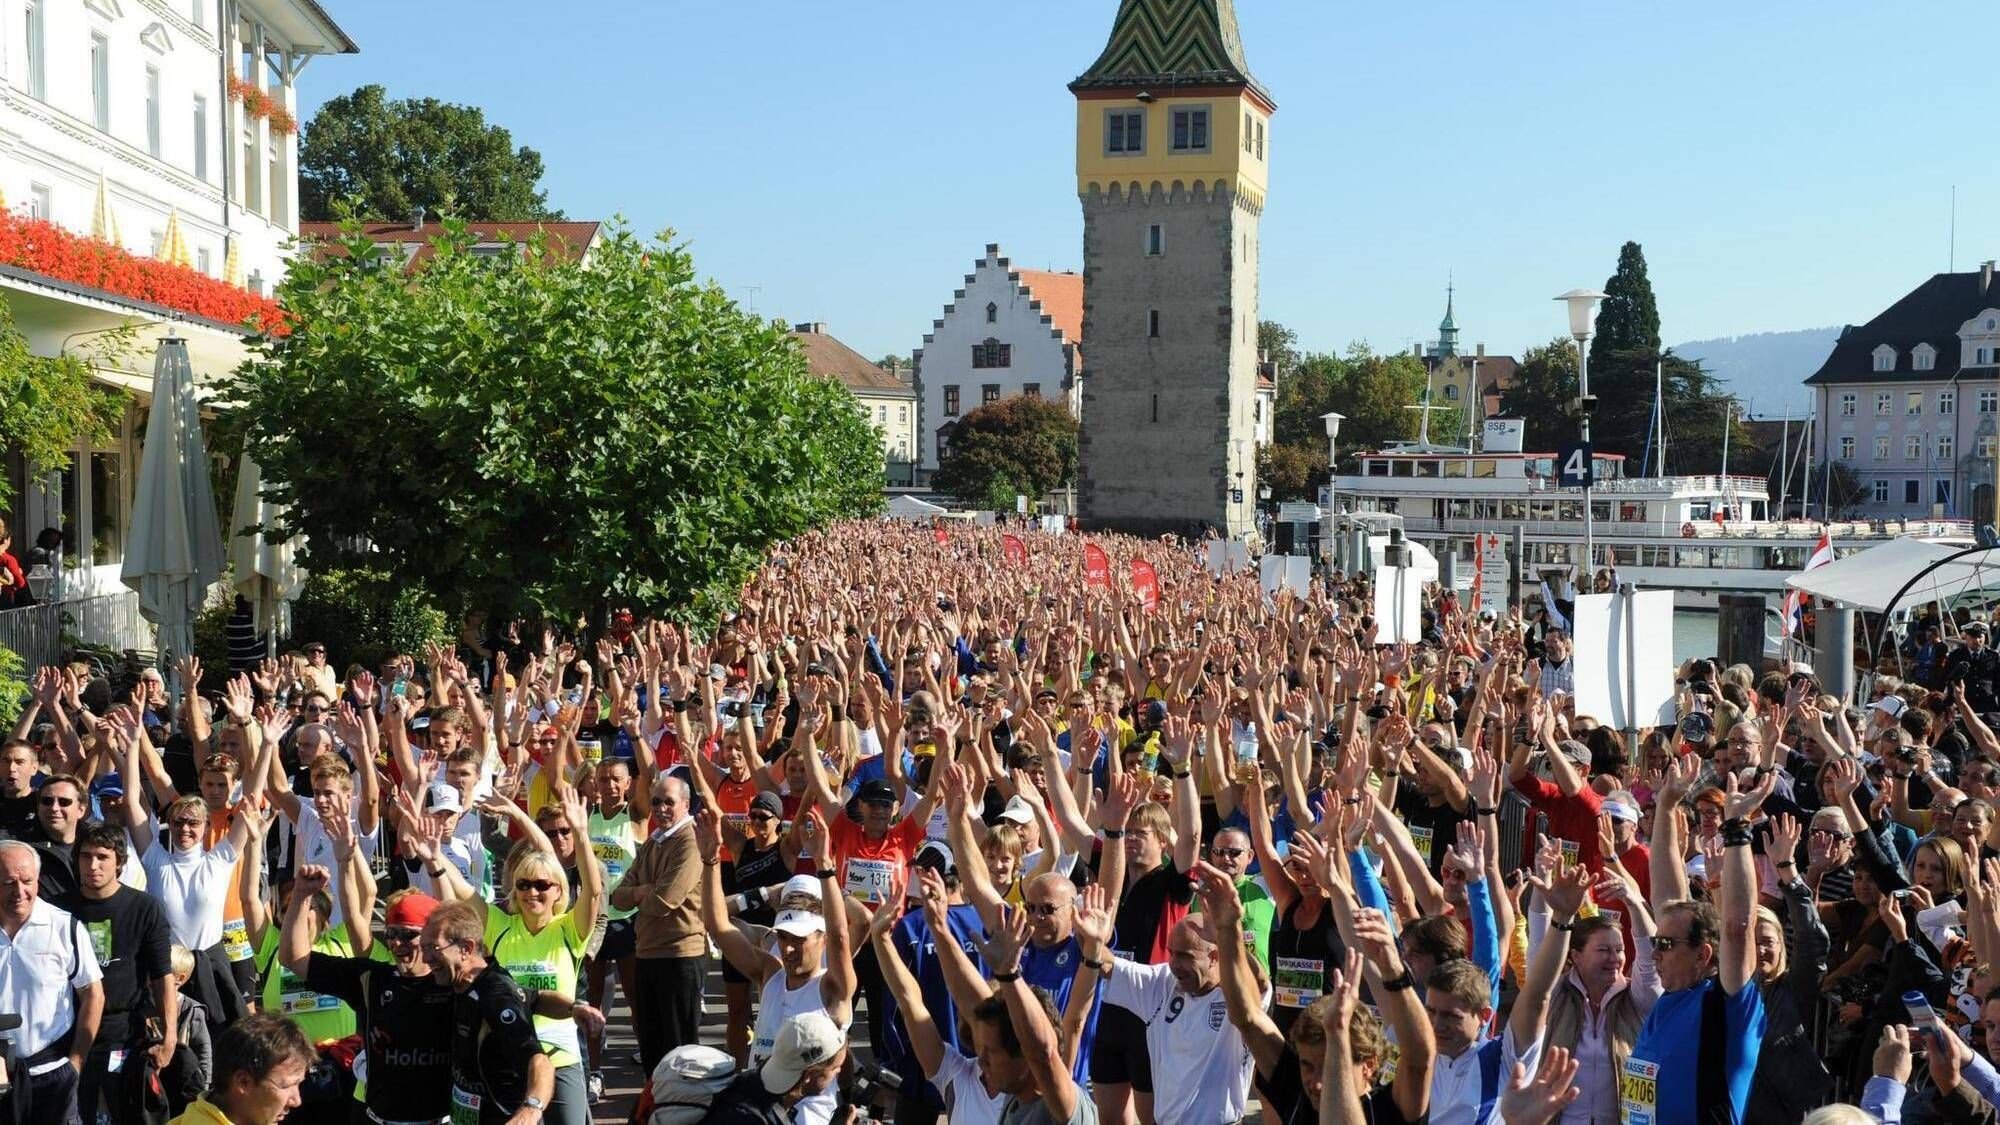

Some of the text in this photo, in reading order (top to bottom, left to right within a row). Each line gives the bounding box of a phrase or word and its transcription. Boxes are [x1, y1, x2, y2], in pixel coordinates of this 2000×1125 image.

[1563, 448, 1588, 480] 4
[603, 845, 624, 860] 2691
[528, 975, 557, 991] 6085
[1164, 996, 1185, 1024] 9
[1628, 1077, 1654, 1103] 2106
